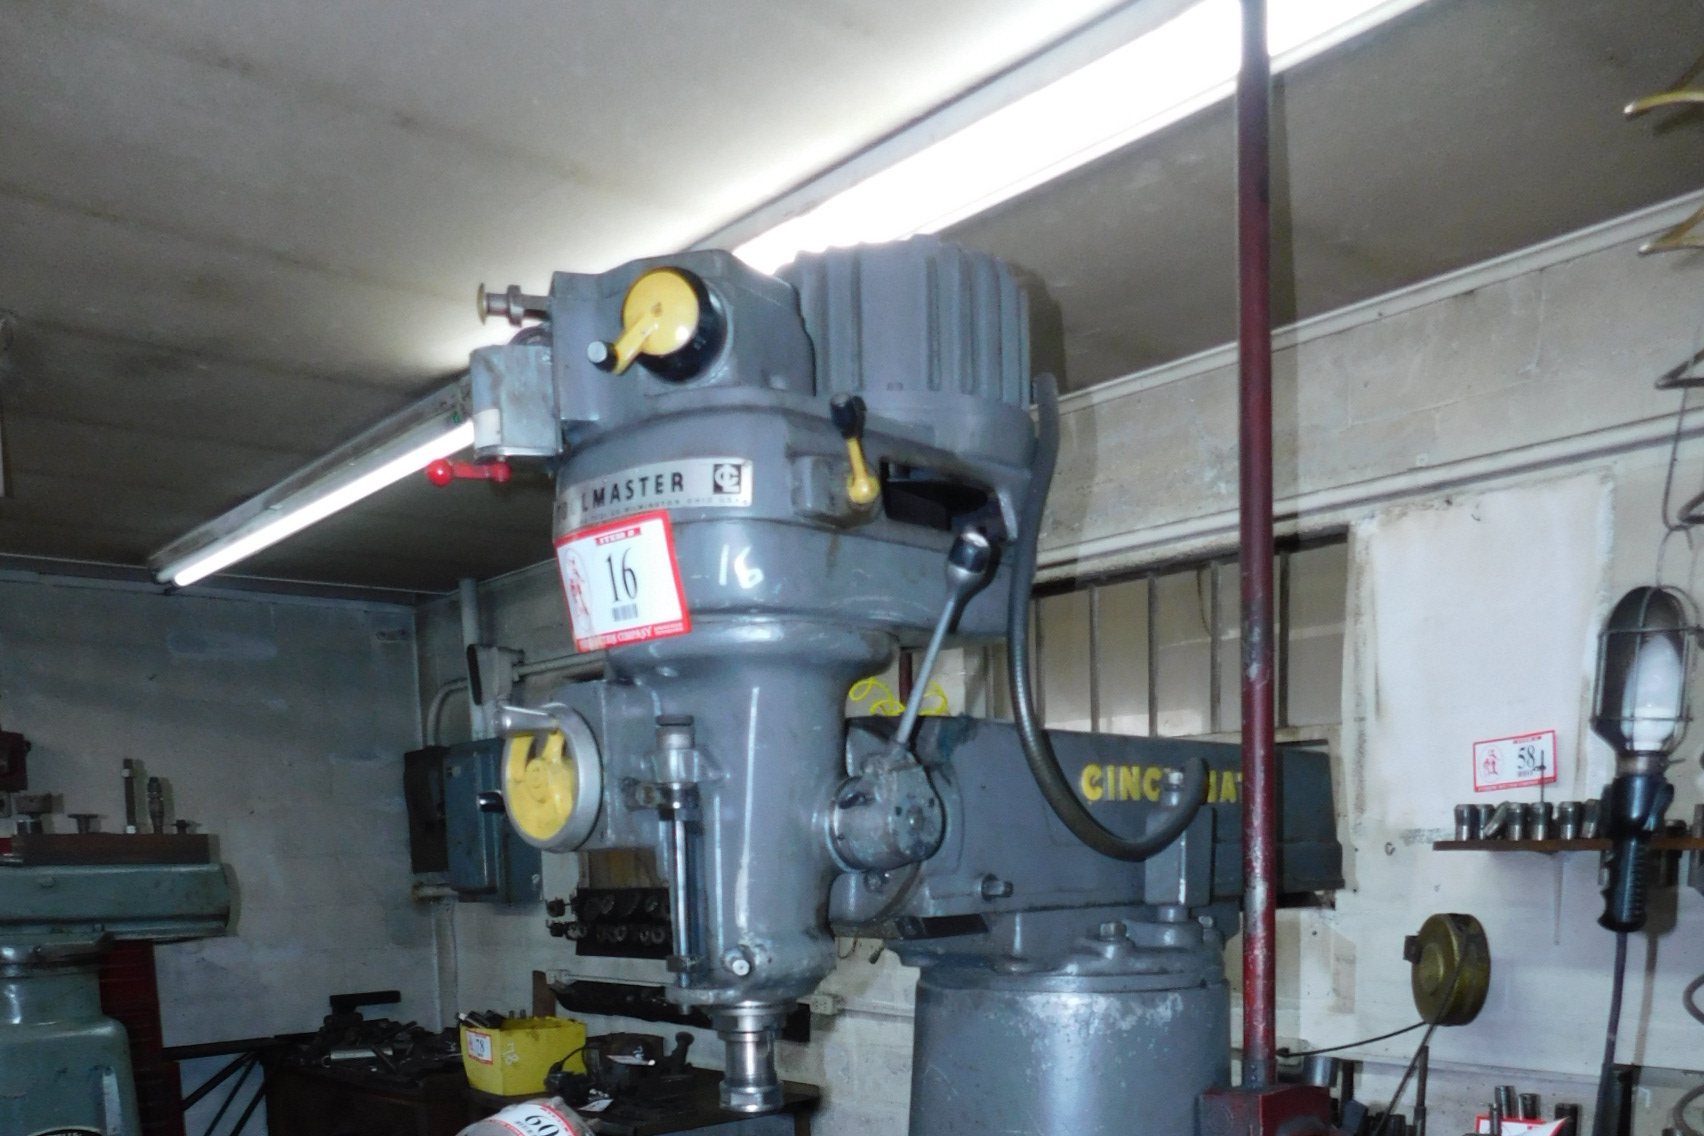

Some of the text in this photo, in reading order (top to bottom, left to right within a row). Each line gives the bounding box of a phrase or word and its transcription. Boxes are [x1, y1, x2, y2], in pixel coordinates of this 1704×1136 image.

[606, 547, 638, 602] 16
[719, 545, 764, 589] 16
[1517, 745, 1535, 769] 58
